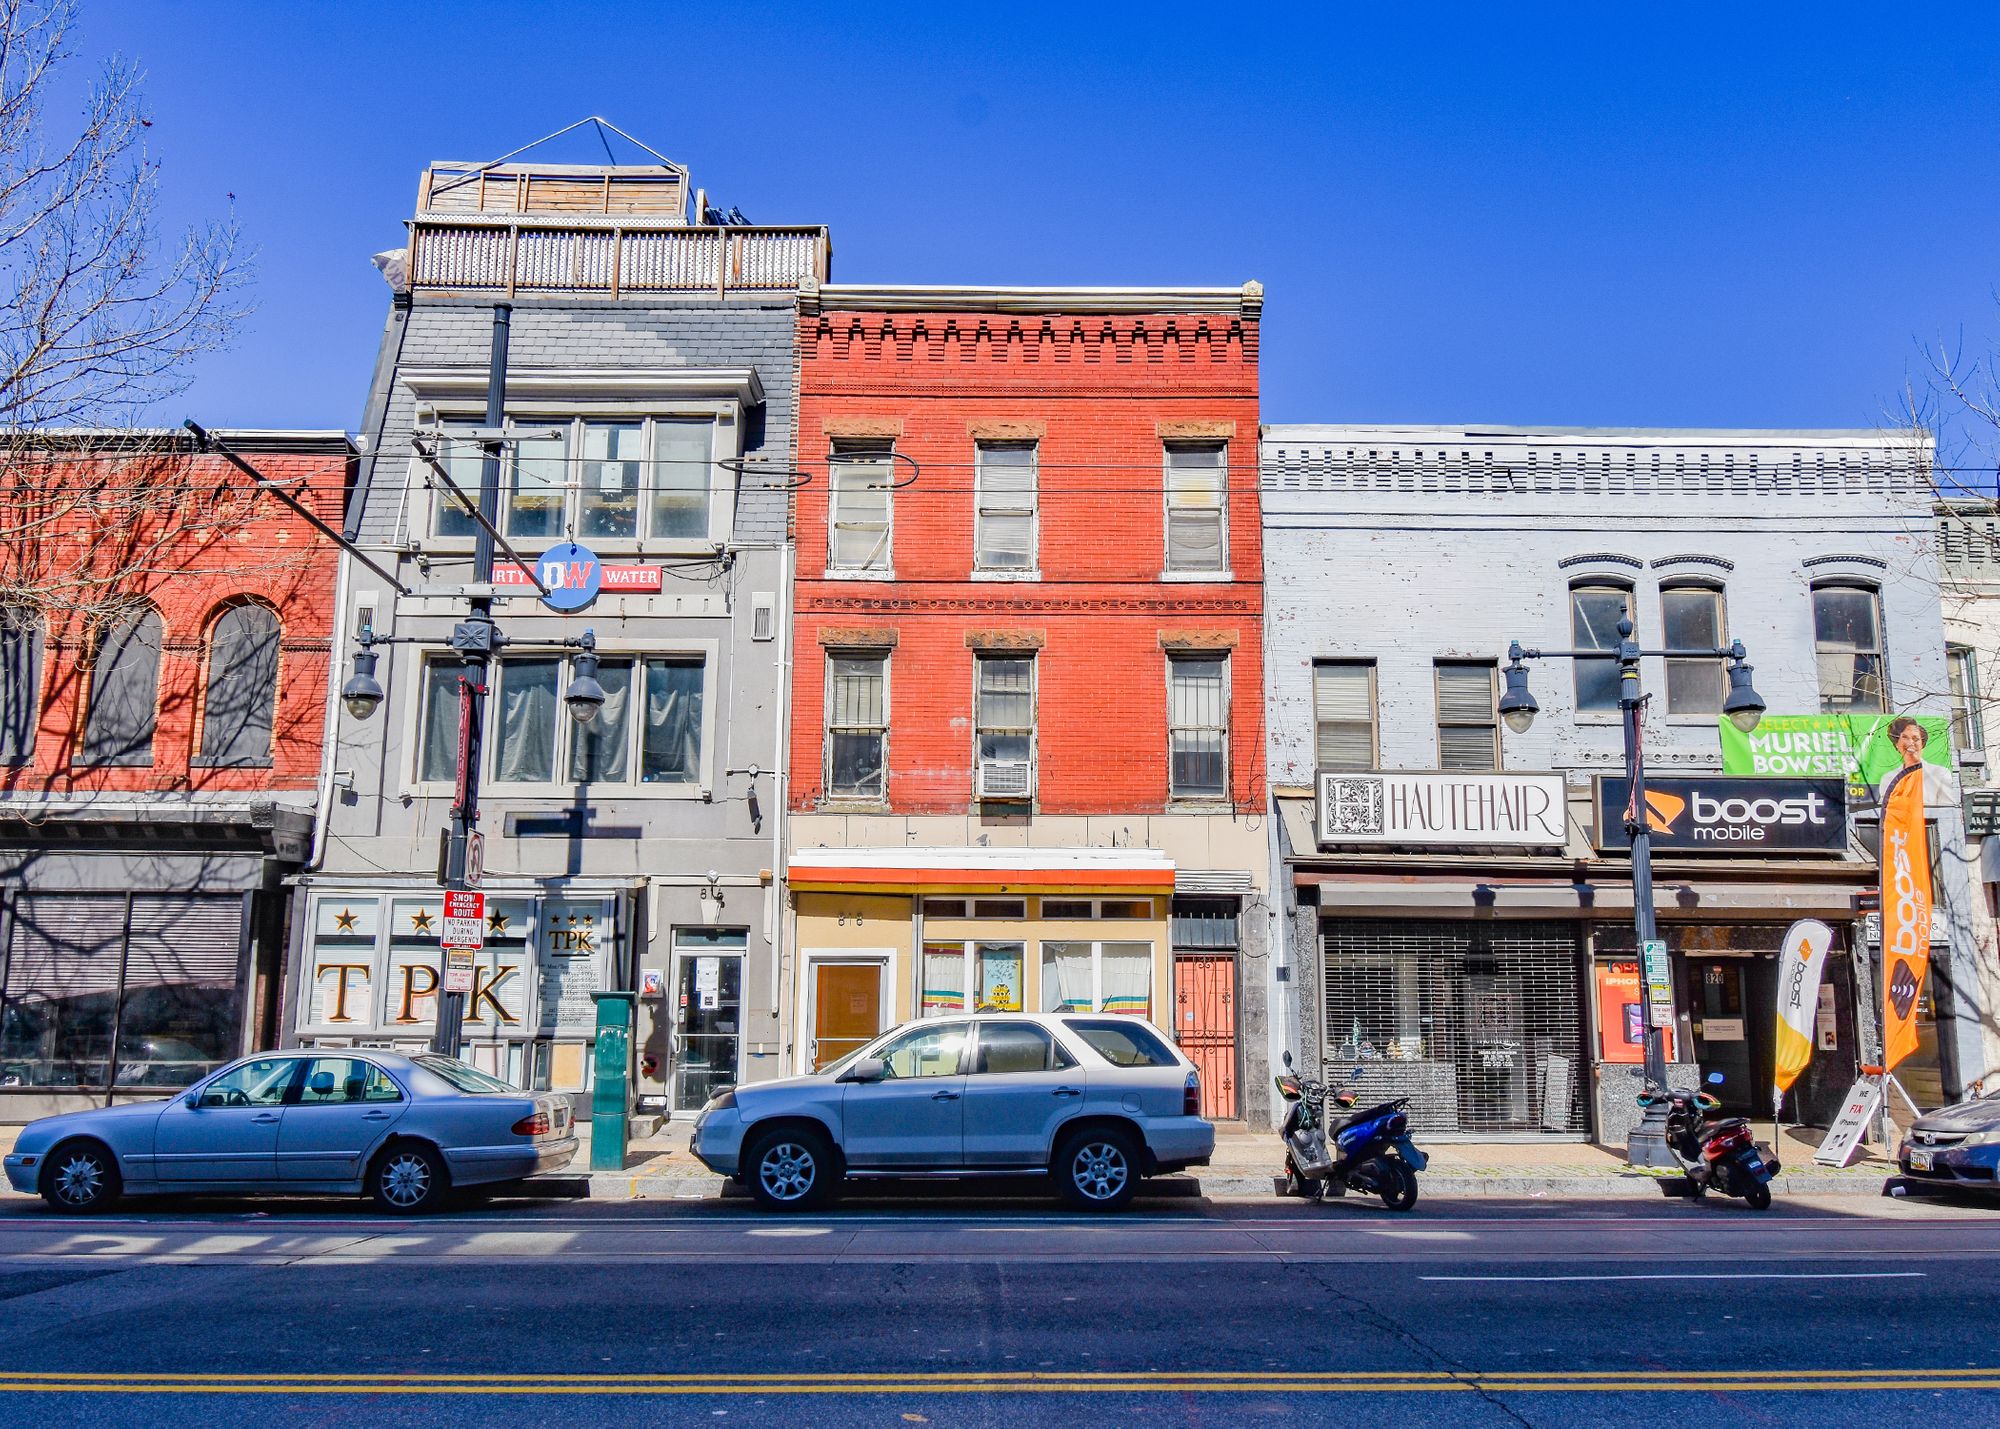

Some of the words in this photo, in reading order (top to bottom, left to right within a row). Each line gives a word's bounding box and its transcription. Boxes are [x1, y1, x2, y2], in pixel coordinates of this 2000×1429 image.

[491, 569, 526, 583] IRTY
[606, 571, 658, 584] WATER
[1757, 719, 1809, 730] ELECT
[1748, 731, 1853, 753] MURIEL
[1753, 754, 1859, 774] BOWSER
[1391, 782, 1565, 837] HAUTEHAIR
[1691, 791, 1826, 824] boost
[1694, 825, 1766, 840] mobile
[453, 893, 476, 902] SNOW
[1890, 829, 1918, 956] boost
[449, 901, 480, 909] EMERGENCY
[453, 908, 475, 917] ROUTE
[457, 919, 480, 927] PARKING
[452, 928, 474, 936] DURING
[446, 935, 480, 944] EMERGENCY
[548, 931, 592, 949] TPK
[1789, 960, 1808, 1009] boost
[1859, 1090, 1869, 1098] WE
[1849, 1104, 1864, 1114] FIX
